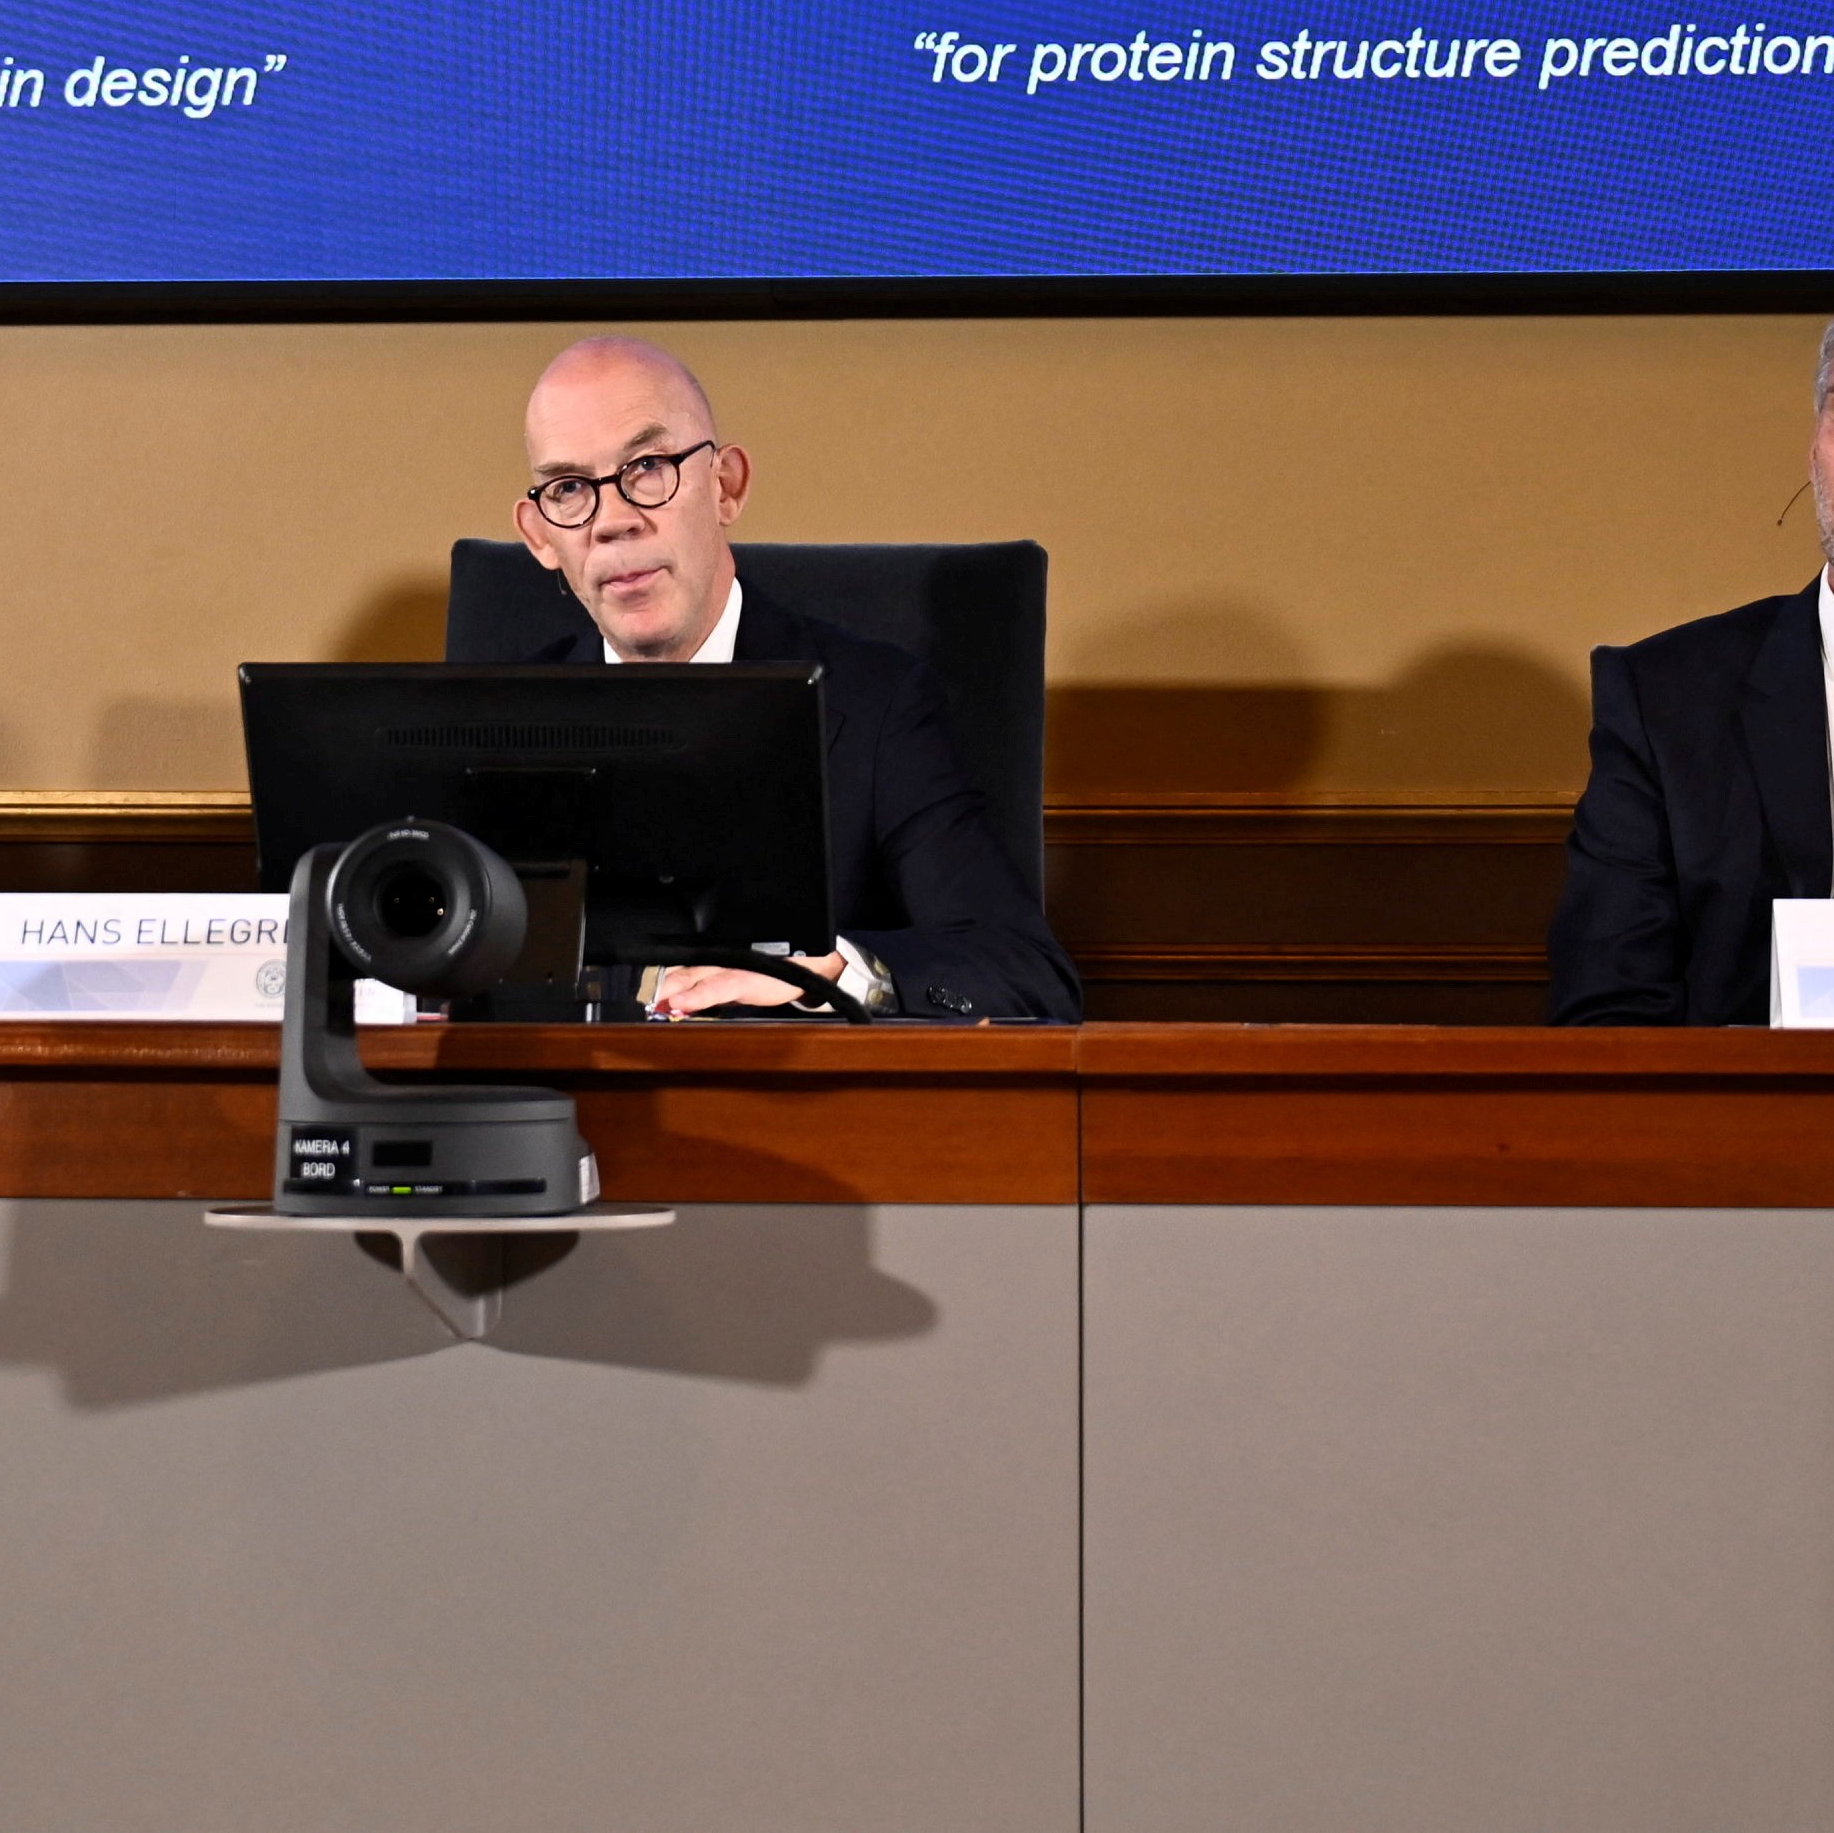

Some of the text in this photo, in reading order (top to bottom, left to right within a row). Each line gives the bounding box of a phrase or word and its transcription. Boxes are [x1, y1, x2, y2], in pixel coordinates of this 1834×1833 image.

[915, 32, 1016, 82] “for
[1027, 30, 1234, 94] protein
[1257, 28, 1520, 79] structure
[65, 55, 286, 118] design”
[22, 919, 121, 944] HANS
[294, 1140, 350, 1155] KAMERA 4
[301, 1163, 335, 1178] BORD
